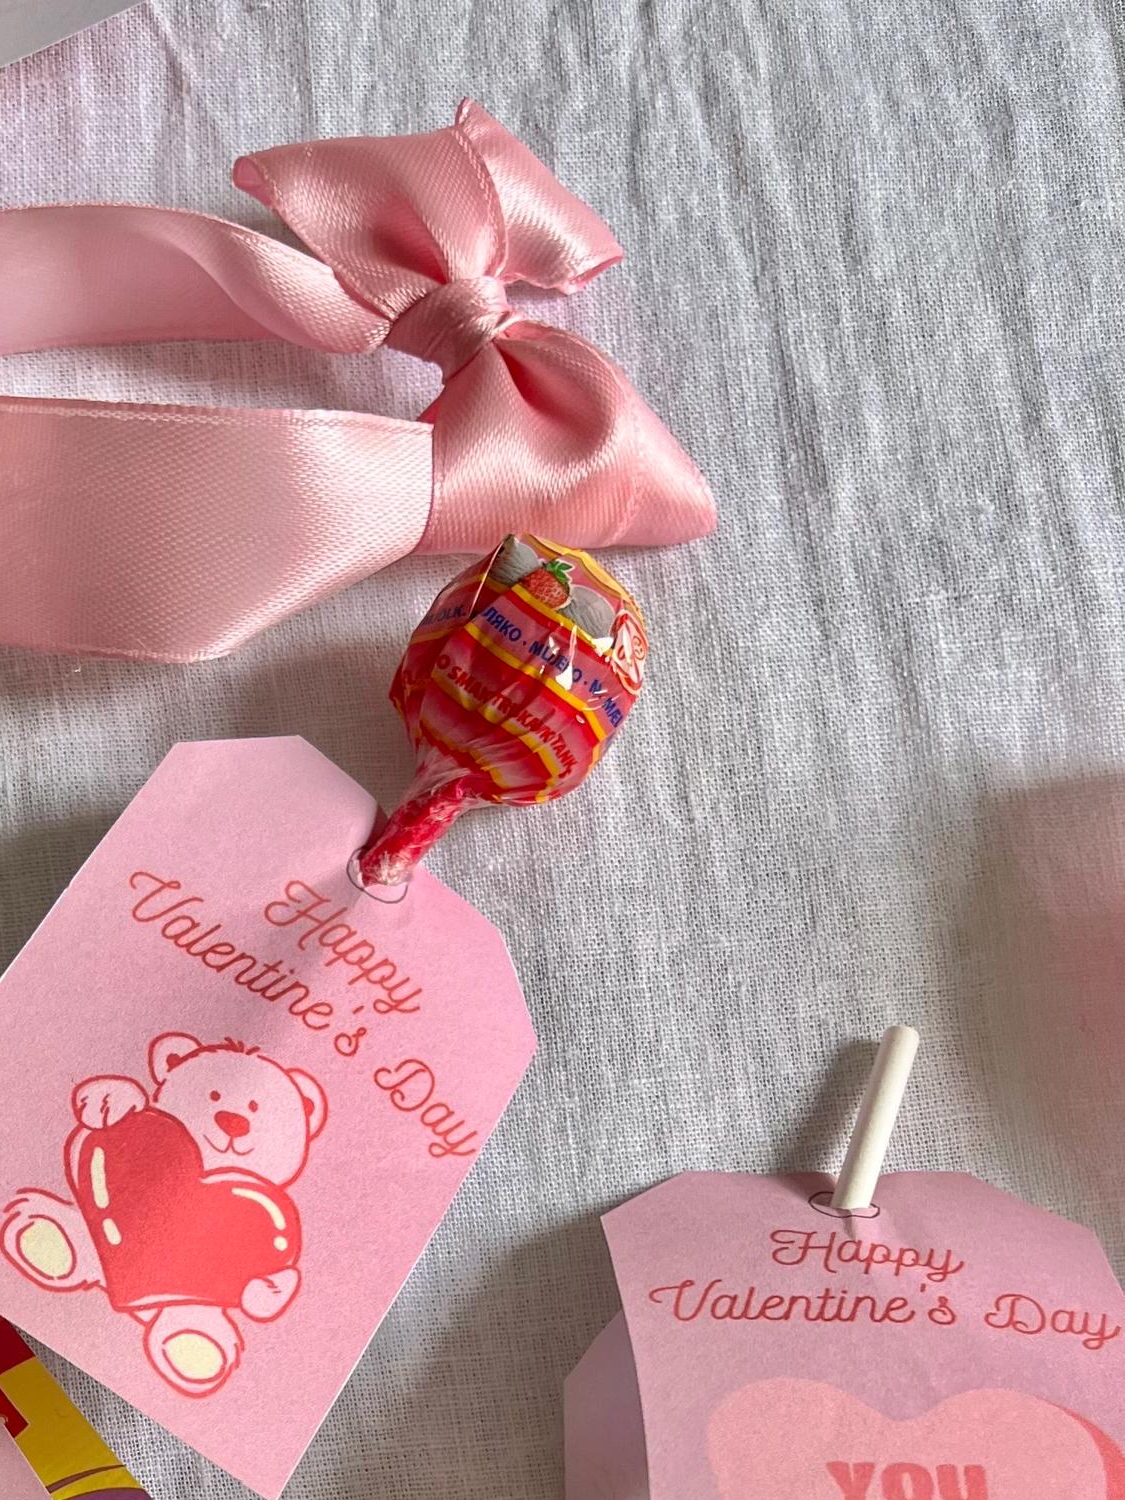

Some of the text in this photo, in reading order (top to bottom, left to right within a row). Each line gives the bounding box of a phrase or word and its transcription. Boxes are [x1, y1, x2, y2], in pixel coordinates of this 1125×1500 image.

[265, 879, 423, 1016] Happy
[128, 869, 477, 1160] Valentine's Day
[770, 1227, 965, 1282] Happy
[648, 1278, 1122, 1350] Valentine's Day
